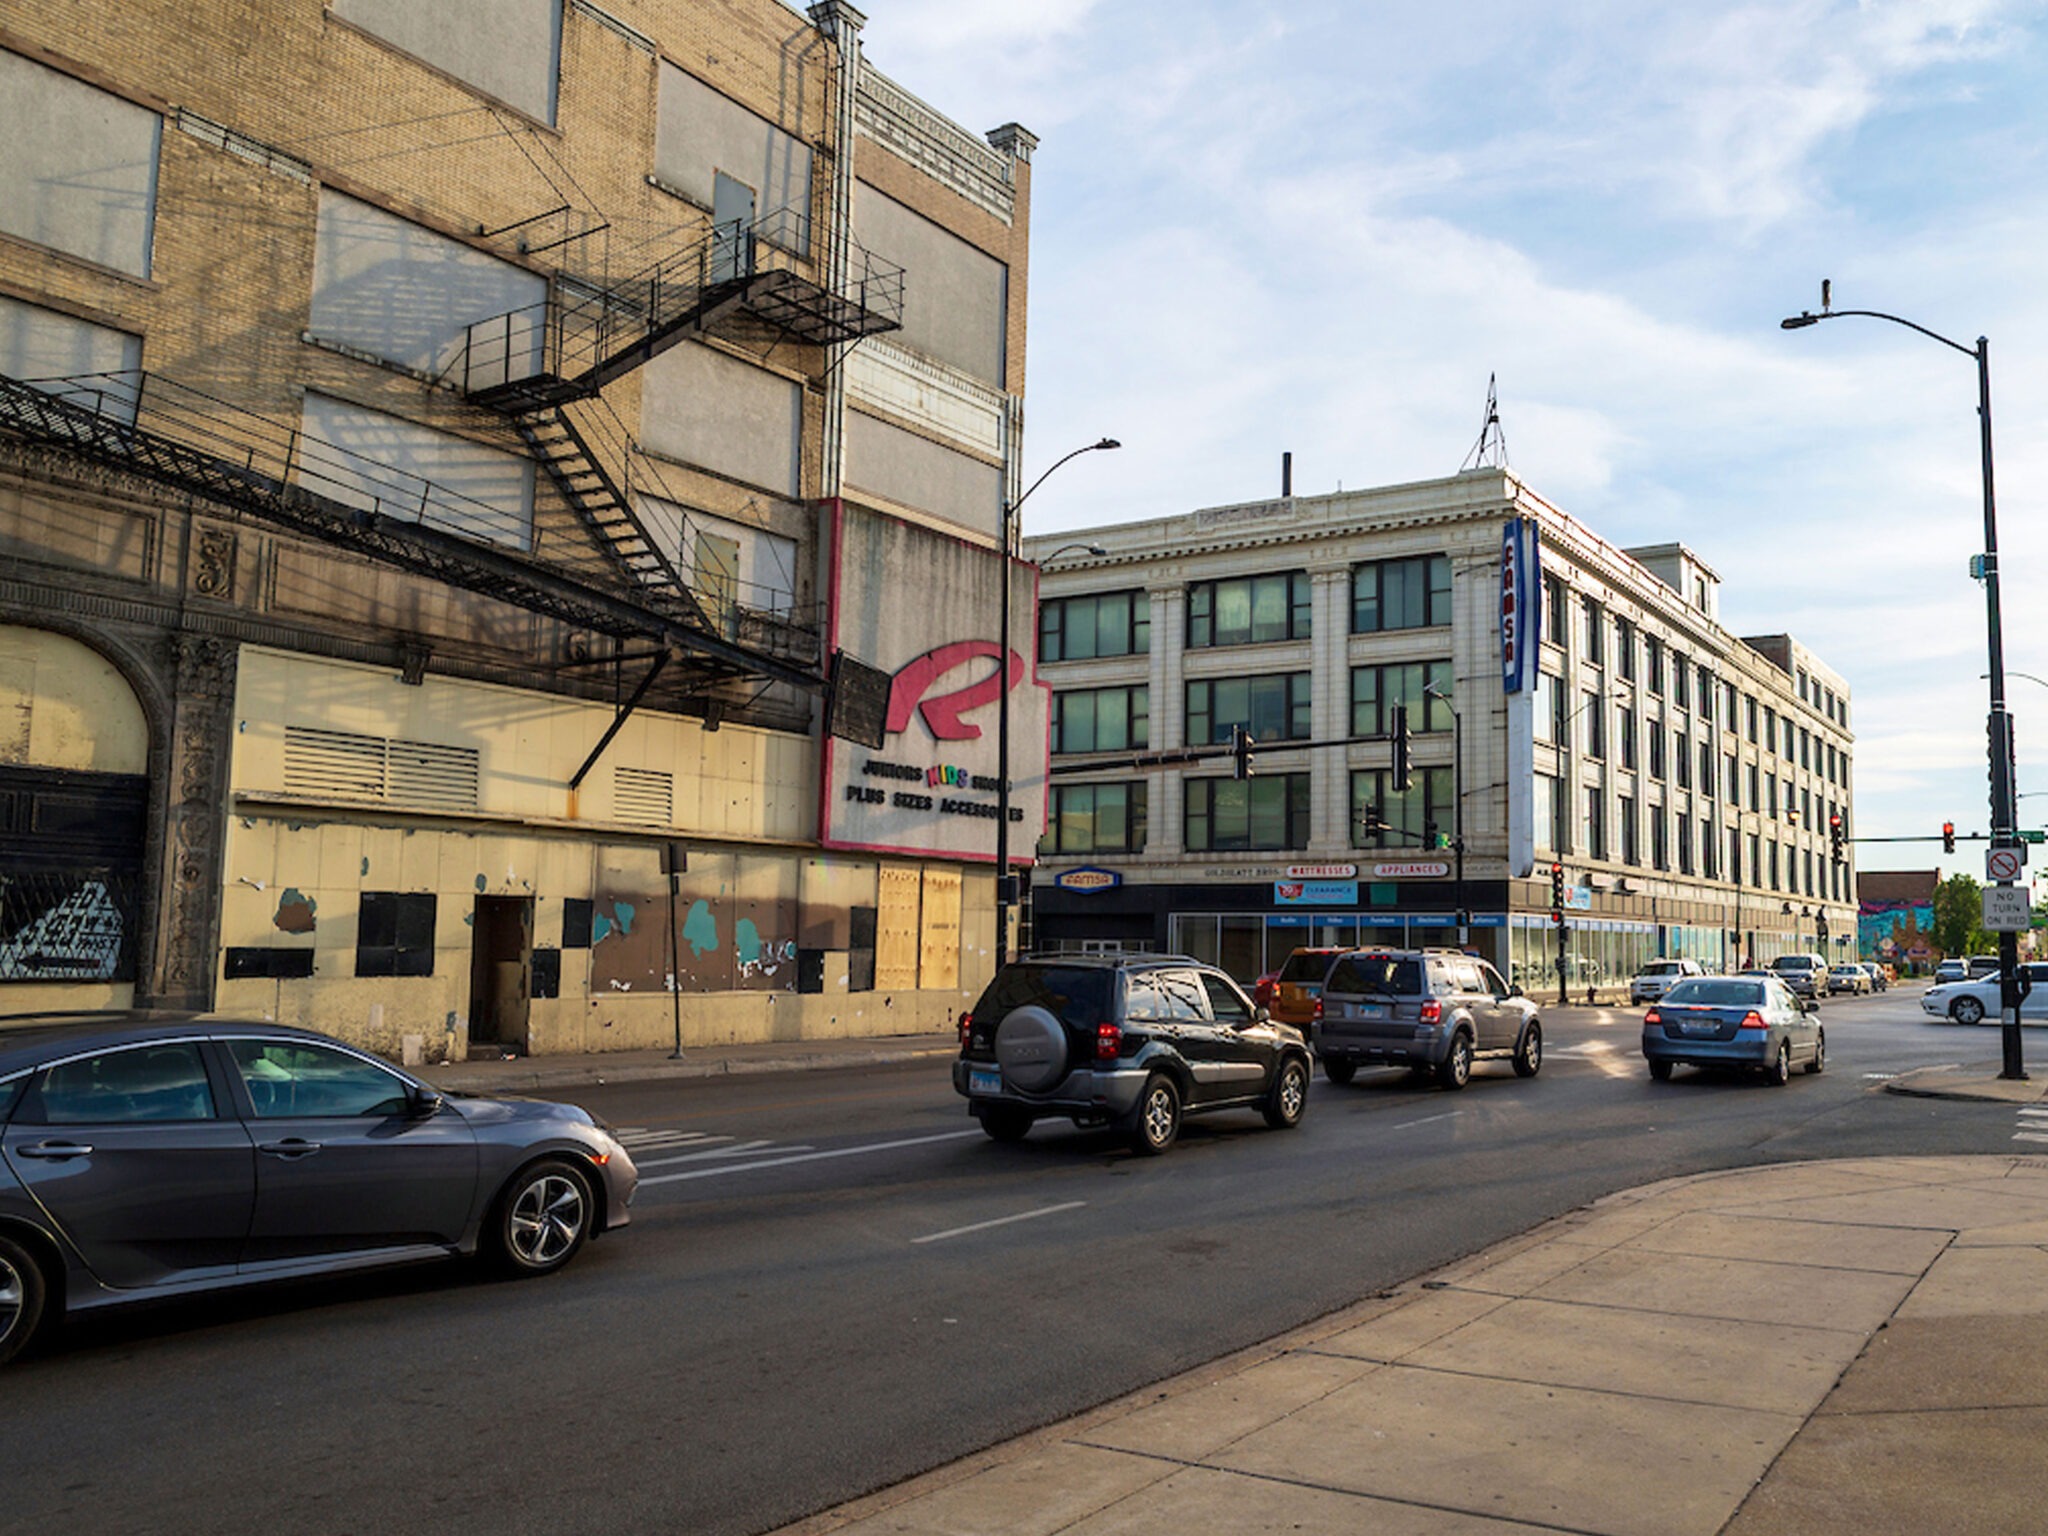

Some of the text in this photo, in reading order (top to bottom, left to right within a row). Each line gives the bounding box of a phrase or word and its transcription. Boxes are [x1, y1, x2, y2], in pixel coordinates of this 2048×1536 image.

[862, 759, 1013, 793] JUNIORS KIDS SHOS
[846, 785, 1024, 822] PLUS SIZES ACCESSOES
[1291, 866, 1352, 875] MATTRESSES
[1381, 864, 1441, 874] APPLIANCES
[1996, 892, 2014, 901] NO
[1992, 903, 2020, 913] TURN
[1987, 916, 2026, 925] ON RED
